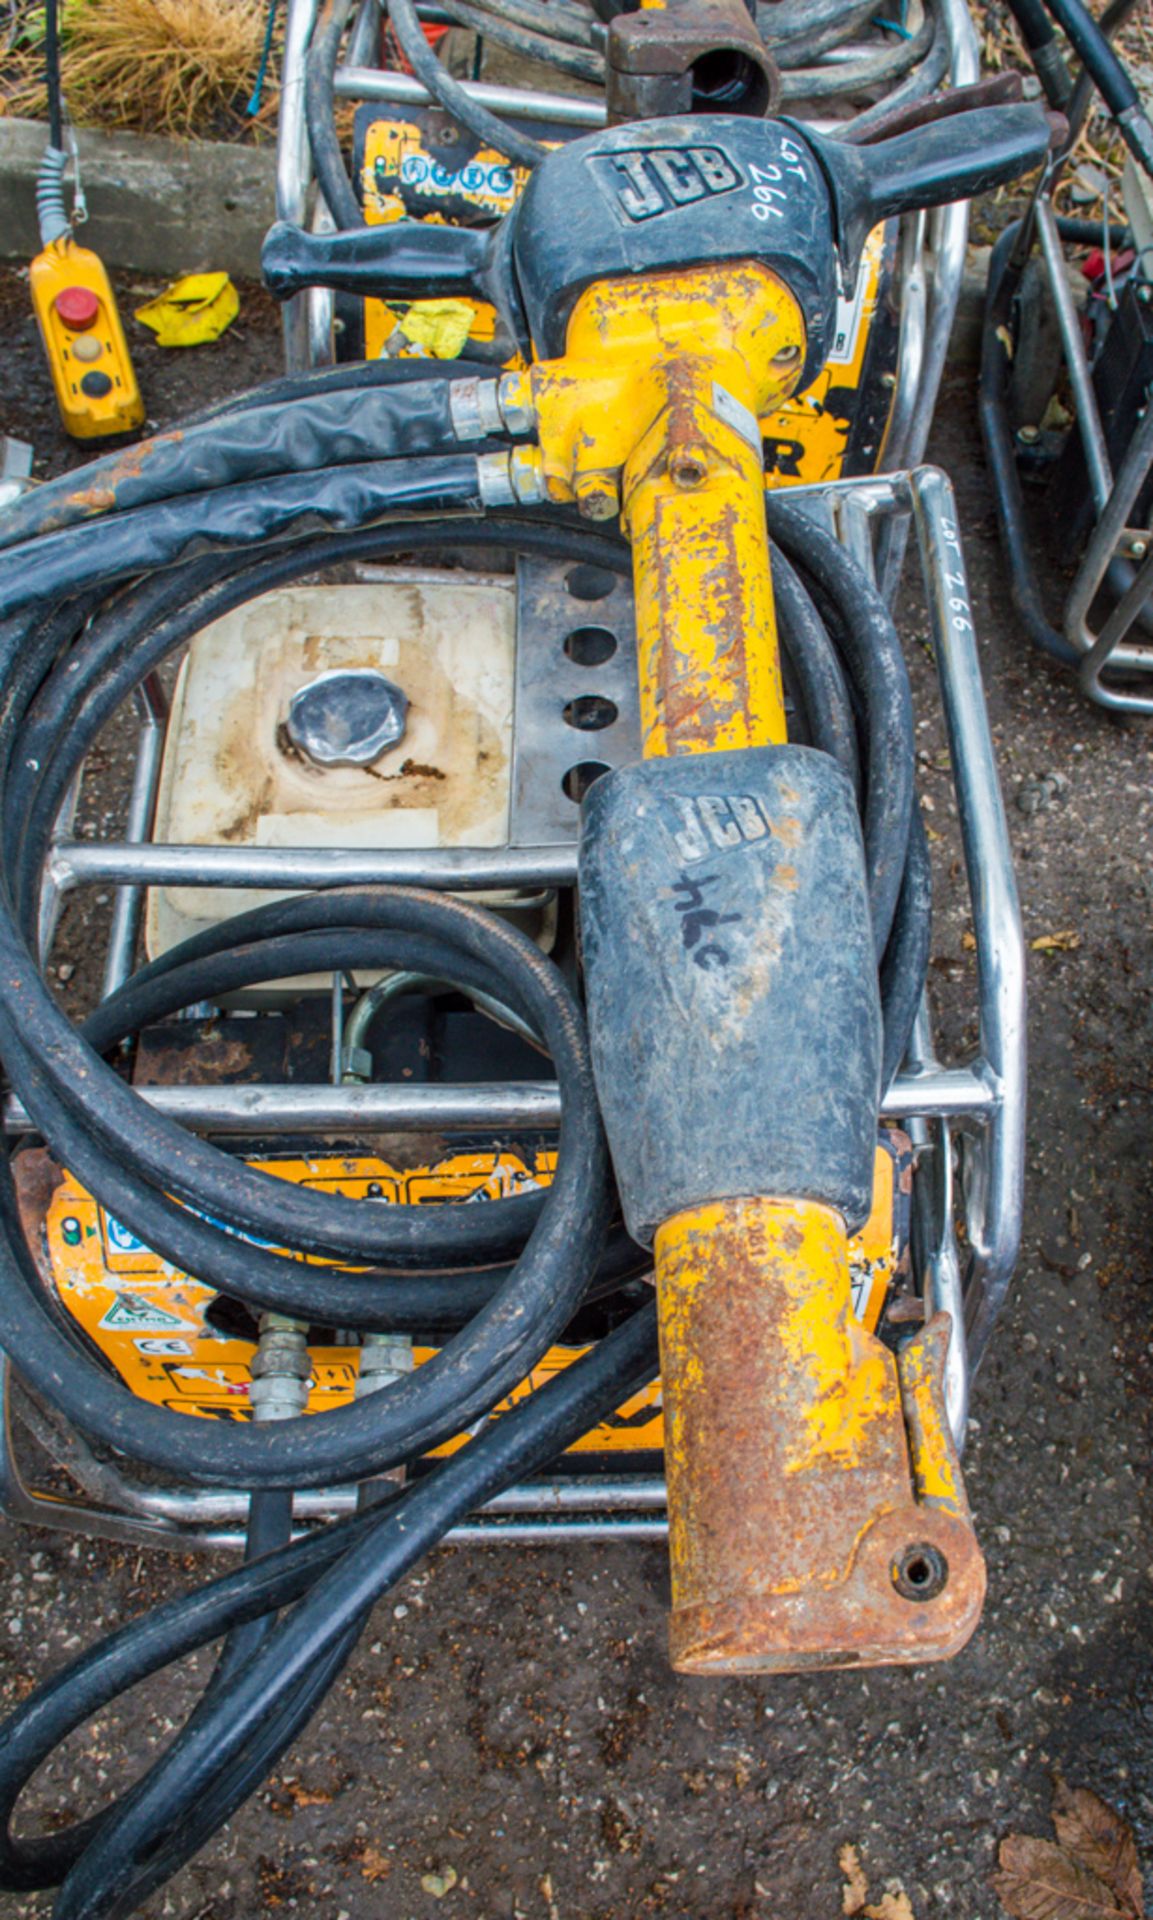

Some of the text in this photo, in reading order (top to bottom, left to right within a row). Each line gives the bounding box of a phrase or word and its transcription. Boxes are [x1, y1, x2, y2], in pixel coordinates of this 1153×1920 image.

[611, 149, 738, 218] JCB
[749, 164, 787, 222] 266
[780, 138, 807, 183] LOT
[940, 517, 973, 632] LOT 266
[670, 795, 768, 862] JCB
